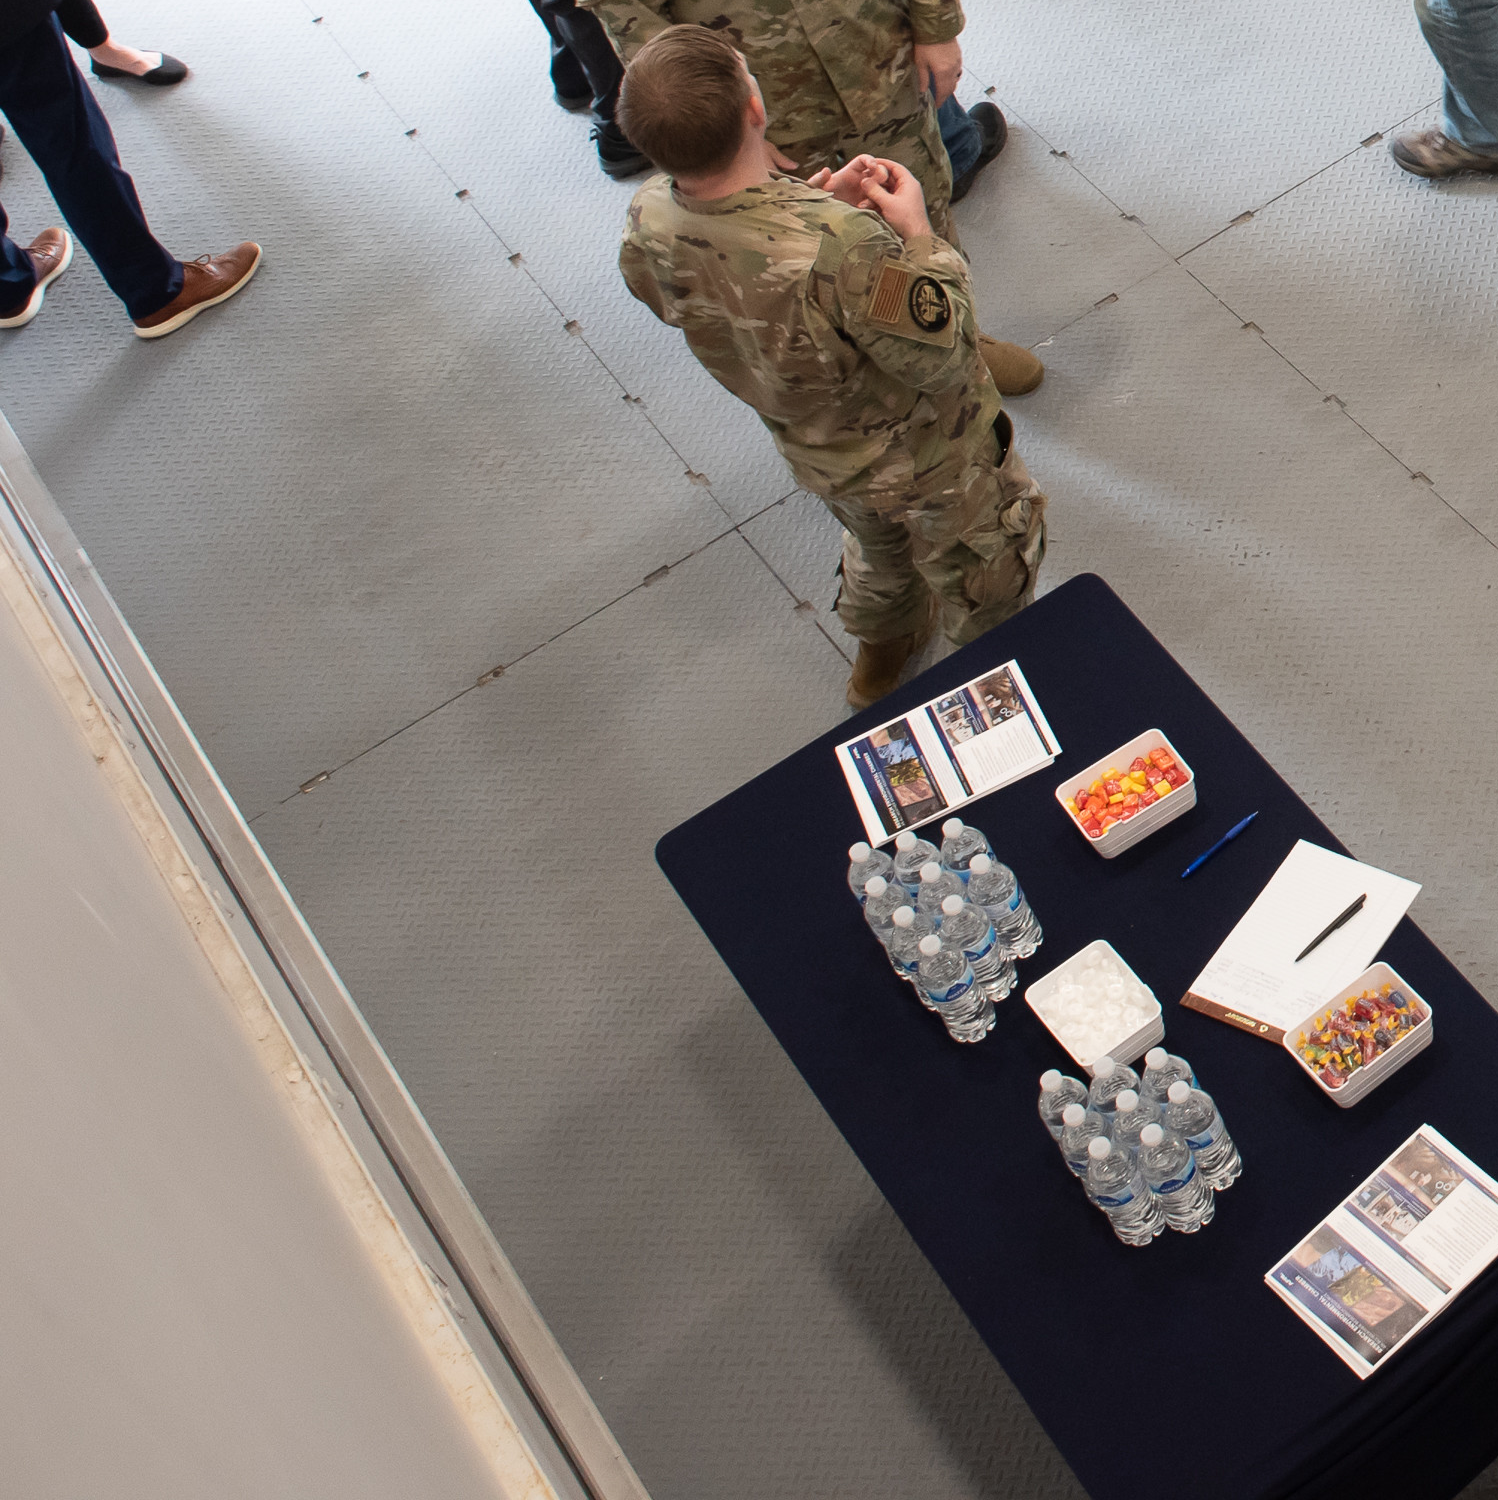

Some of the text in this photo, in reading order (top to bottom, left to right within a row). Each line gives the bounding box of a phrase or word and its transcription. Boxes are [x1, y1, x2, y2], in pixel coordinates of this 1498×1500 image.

[862, 751, 876, 773] CHAMBER
[872, 772, 892, 807] ENVIRONMENTAL
[887, 805, 902, 829] RESEARCH
[1294, 1274, 1320, 1297] CHAMBER
[1317, 1294, 1358, 1331] ENVIRONMENTAL
[1355, 1329, 1383, 1353] RESEARCH
